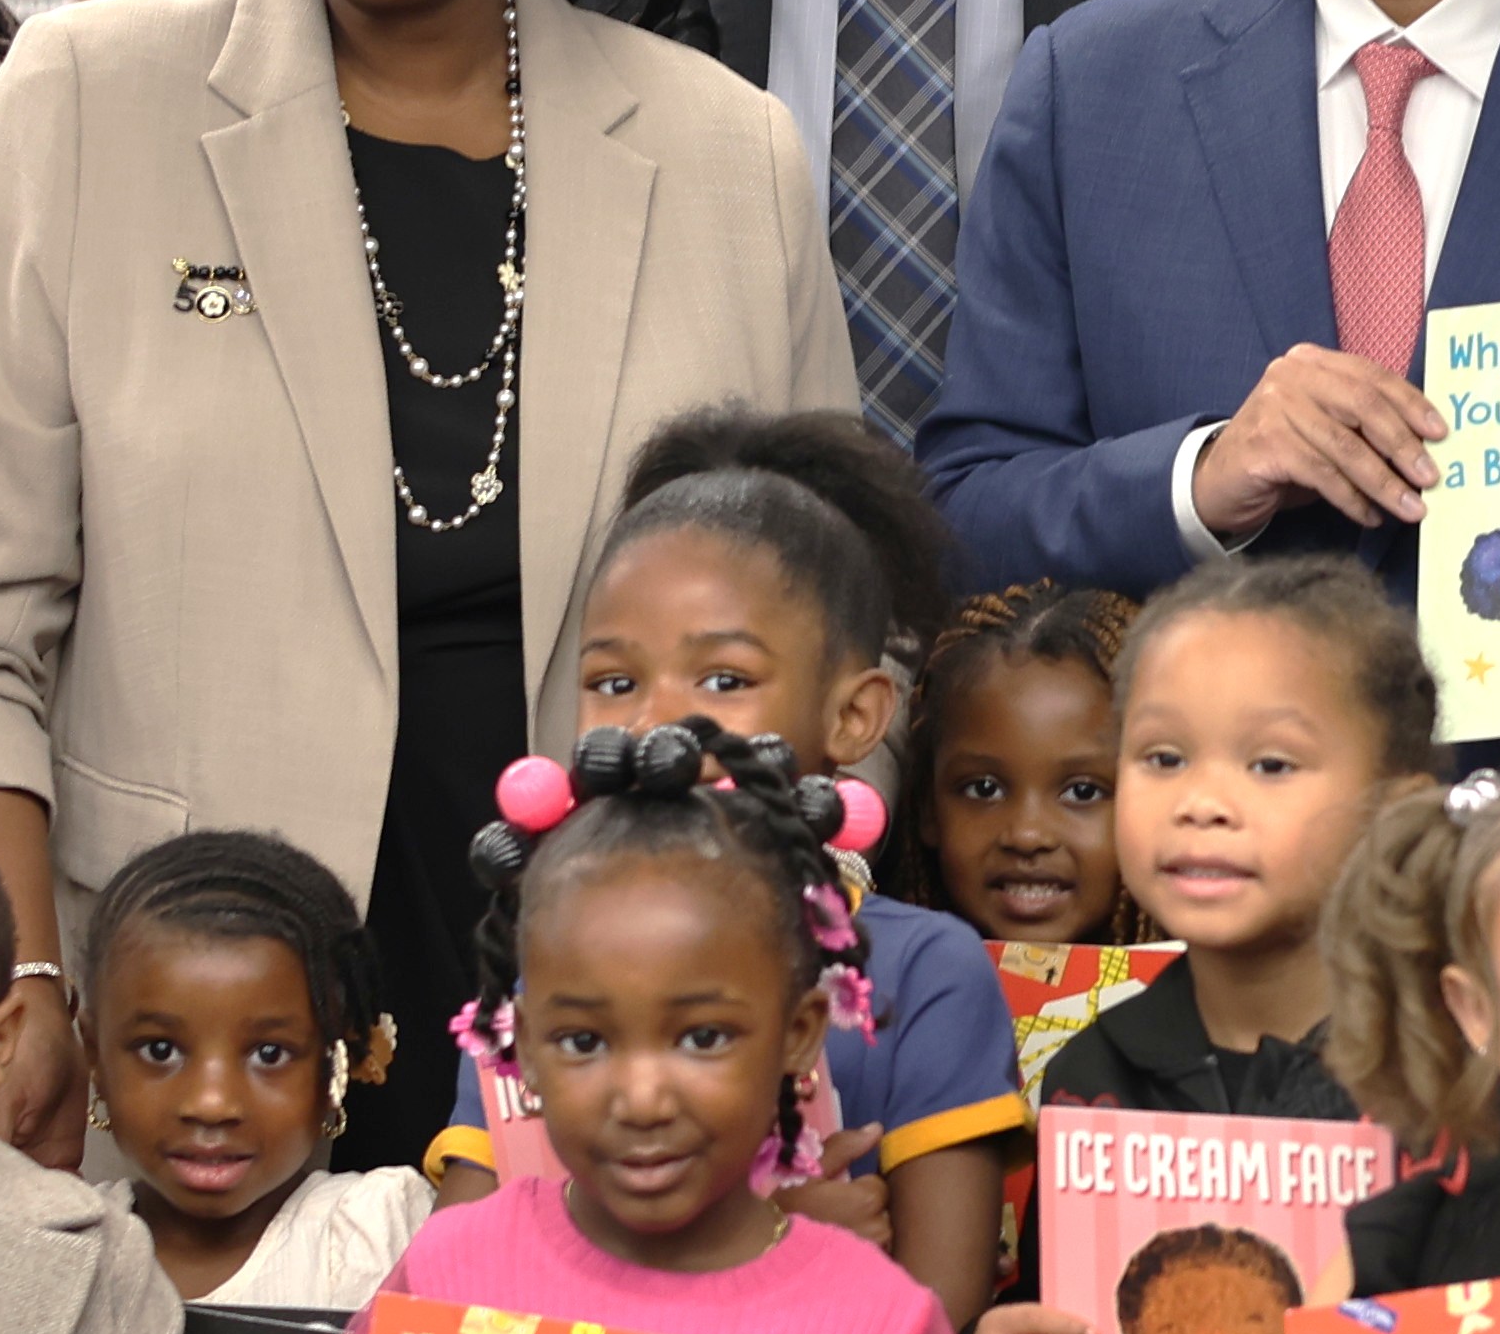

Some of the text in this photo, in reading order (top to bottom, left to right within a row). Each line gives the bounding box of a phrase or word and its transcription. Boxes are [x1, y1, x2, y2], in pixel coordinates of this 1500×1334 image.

[1444, 460, 1466, 489] a
[1055, 1129, 1116, 1196] ICE
[1124, 1132, 1271, 1204] CREAM
